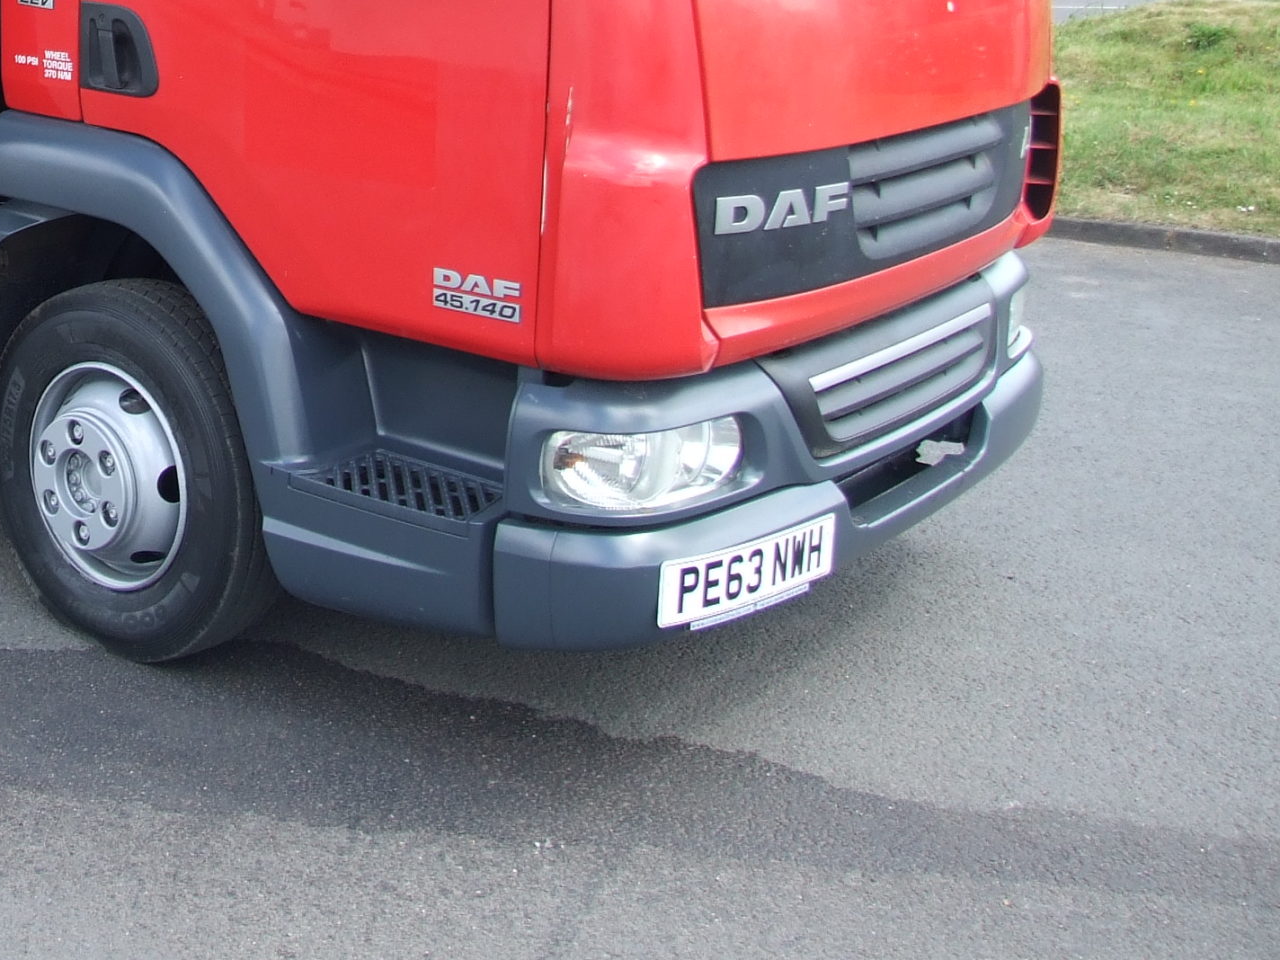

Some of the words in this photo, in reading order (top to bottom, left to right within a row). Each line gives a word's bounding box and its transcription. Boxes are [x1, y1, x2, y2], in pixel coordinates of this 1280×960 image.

[27, 55, 38, 66] PSI
[43, 59, 73, 71] TORQUE
[44, 50, 70, 61] WHEEL
[44, 69, 56, 78] 370
[714, 182, 850, 235] DAF
[433, 267, 520, 298] DAF
[435, 292, 517, 319] 45.140
[677, 548, 763, 614] PE63
[772, 525, 823, 586] NWH
